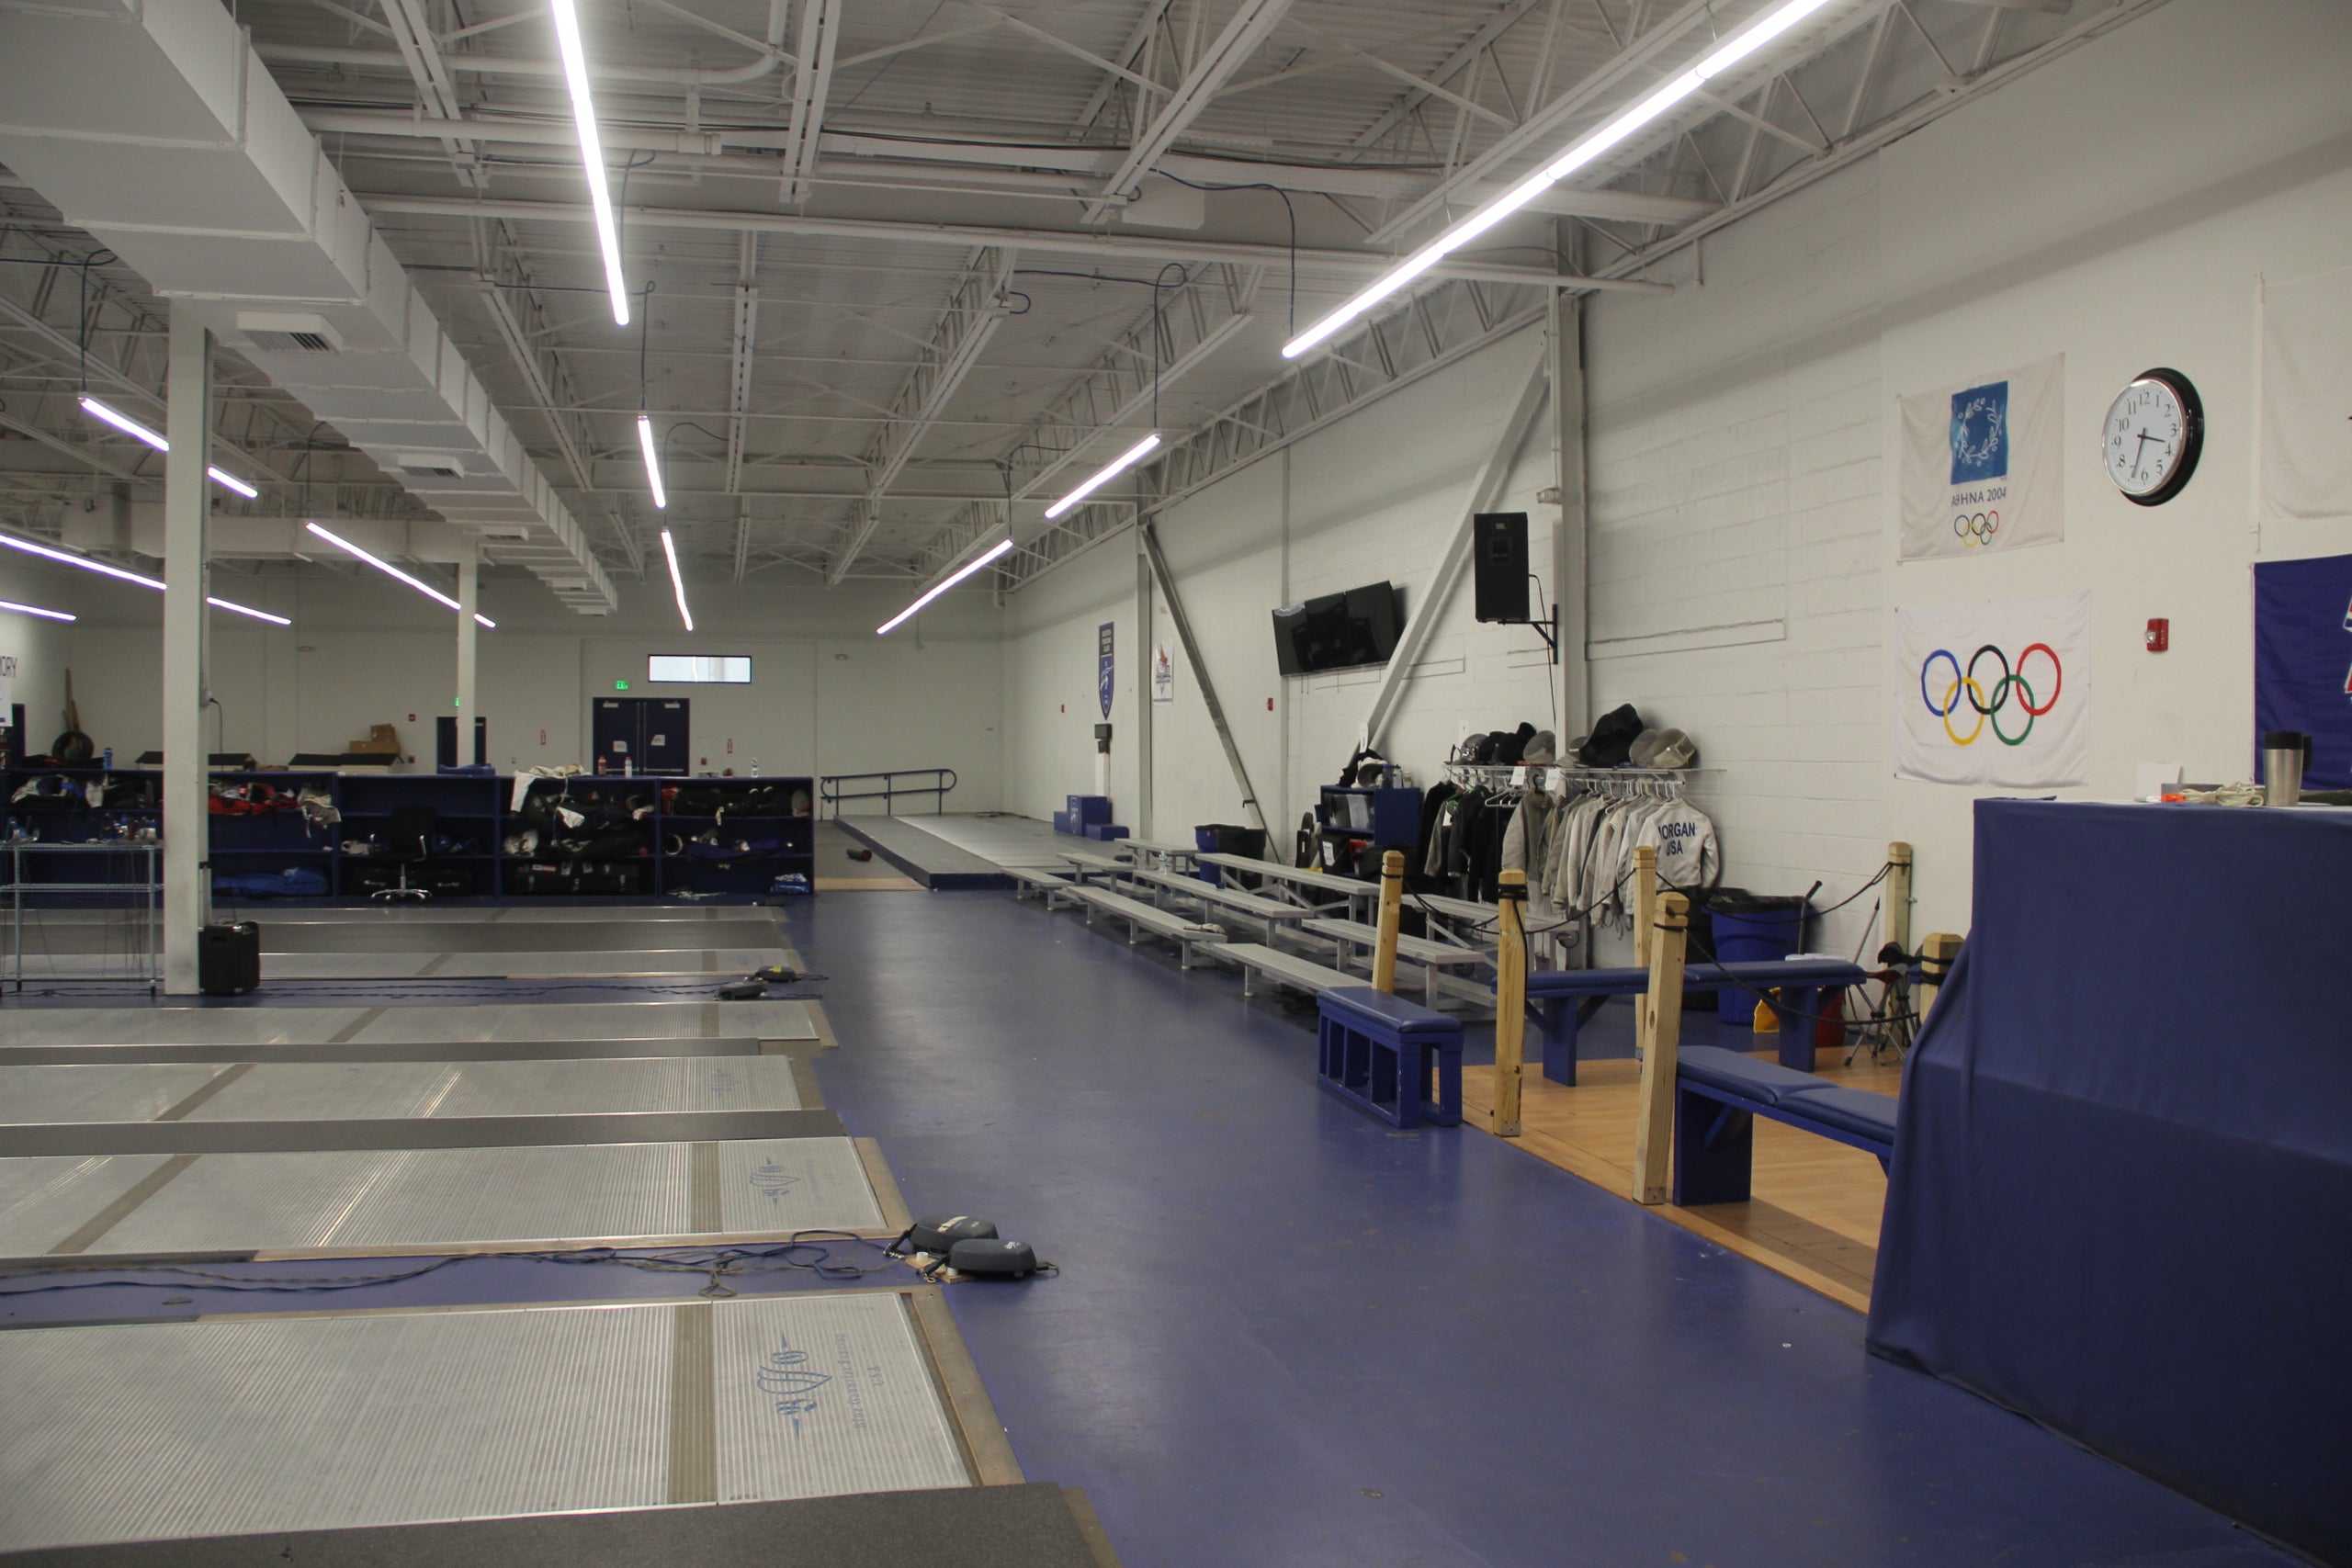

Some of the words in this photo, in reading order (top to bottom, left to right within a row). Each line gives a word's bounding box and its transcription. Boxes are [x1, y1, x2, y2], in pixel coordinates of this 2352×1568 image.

[2139, 391, 2150, 406] 12
[2155, 394, 2160, 408] 1
[2128, 401, 2136, 415] 11
[2165, 403, 2171, 418] 2
[2119, 417, 2130, 432] 10
[2170, 423, 2177, 437] 3
[2114, 434, 2121, 449] 9
[2165, 443, 2173, 457] 4
[2118, 453, 2126, 468] 8
[2155, 459, 2164, 476] 5
[2141, 468, 2149, 481] 6
[1987, 487, 2007, 502] 2004
[0, 655, 17, 679] ORY
